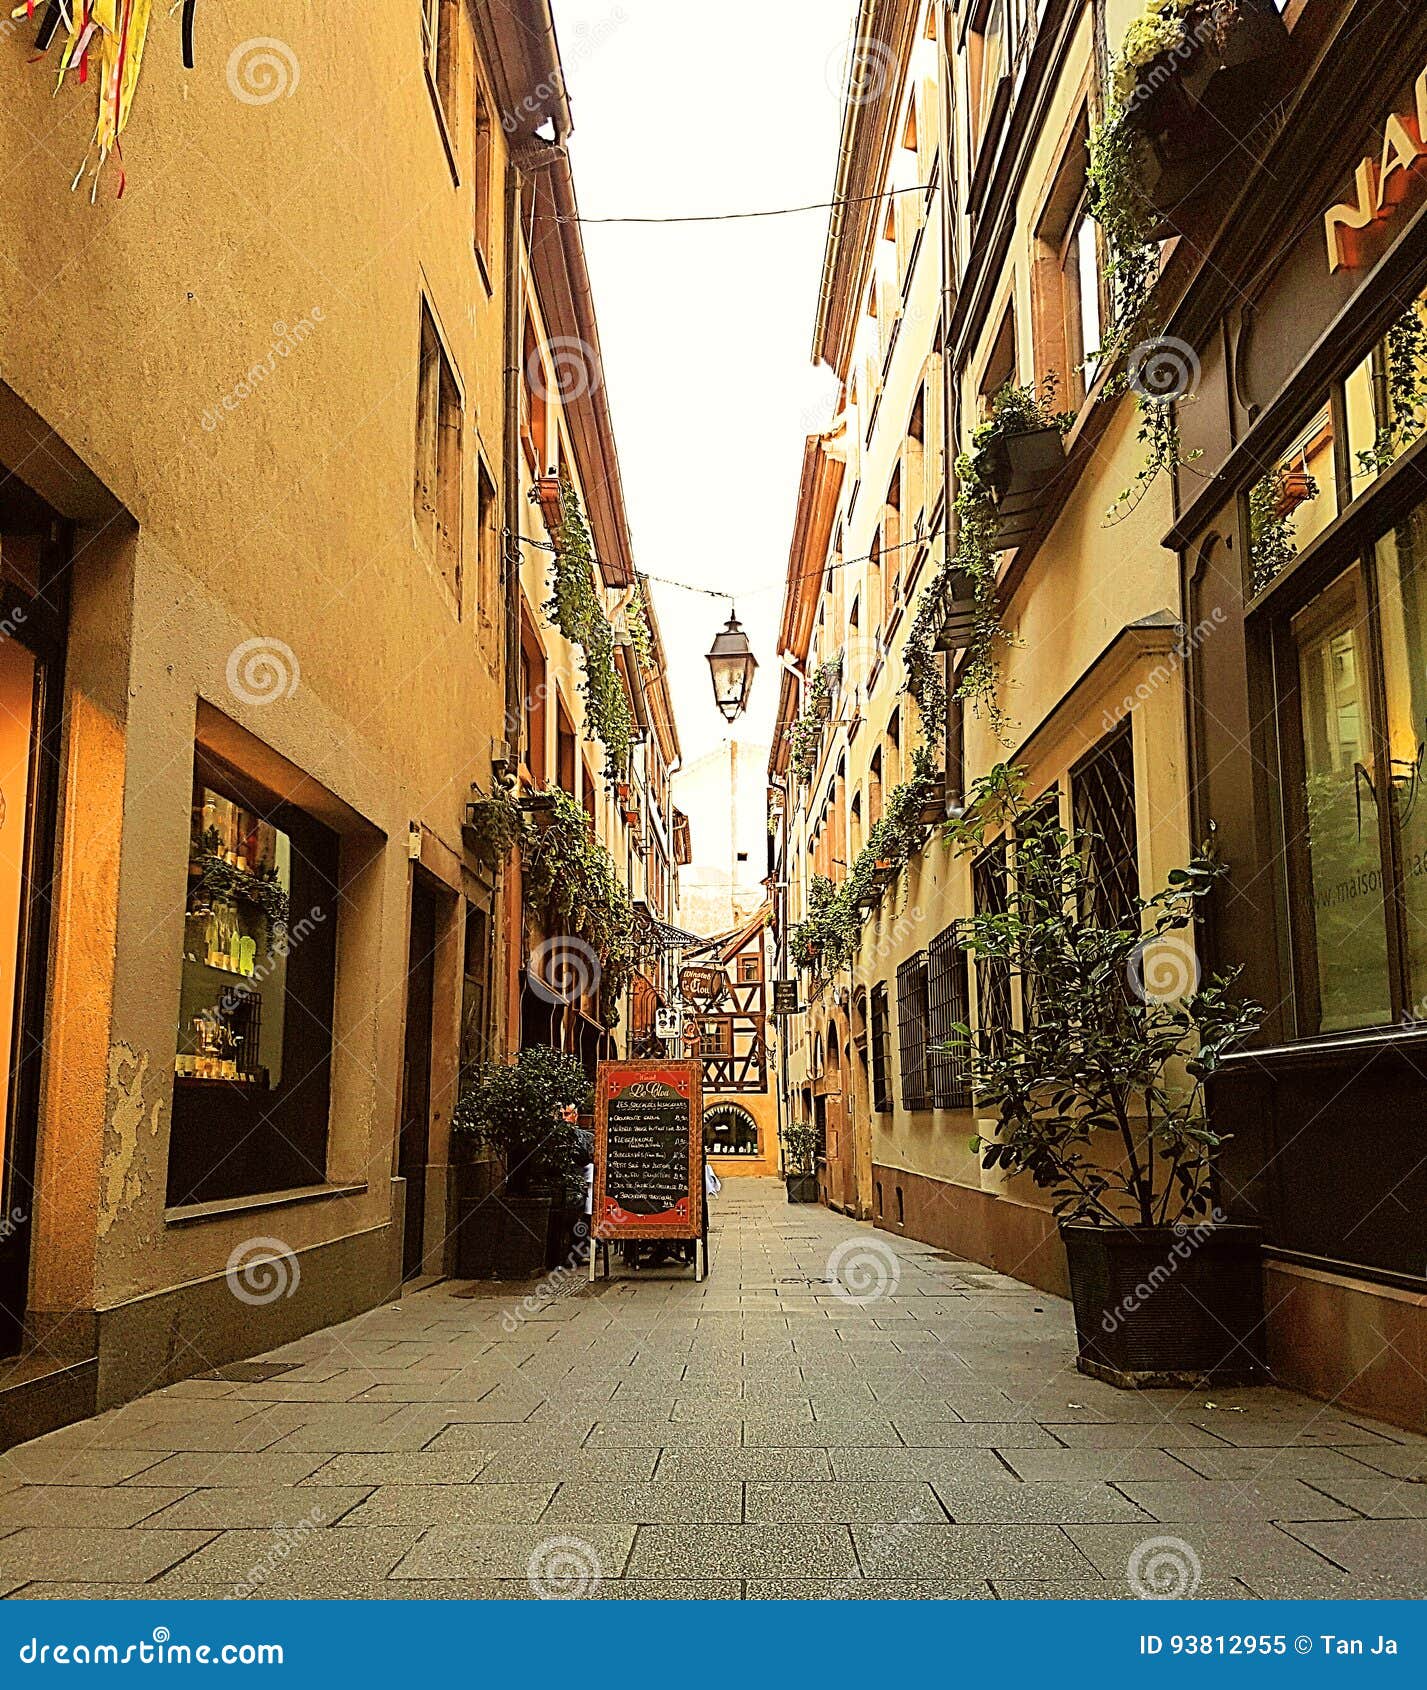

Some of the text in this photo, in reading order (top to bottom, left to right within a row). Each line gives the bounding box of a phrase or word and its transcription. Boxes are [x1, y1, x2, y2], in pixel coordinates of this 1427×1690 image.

[690, 978, 710, 994] Clou
[629, 1081, 671, 1098] Le Clou
